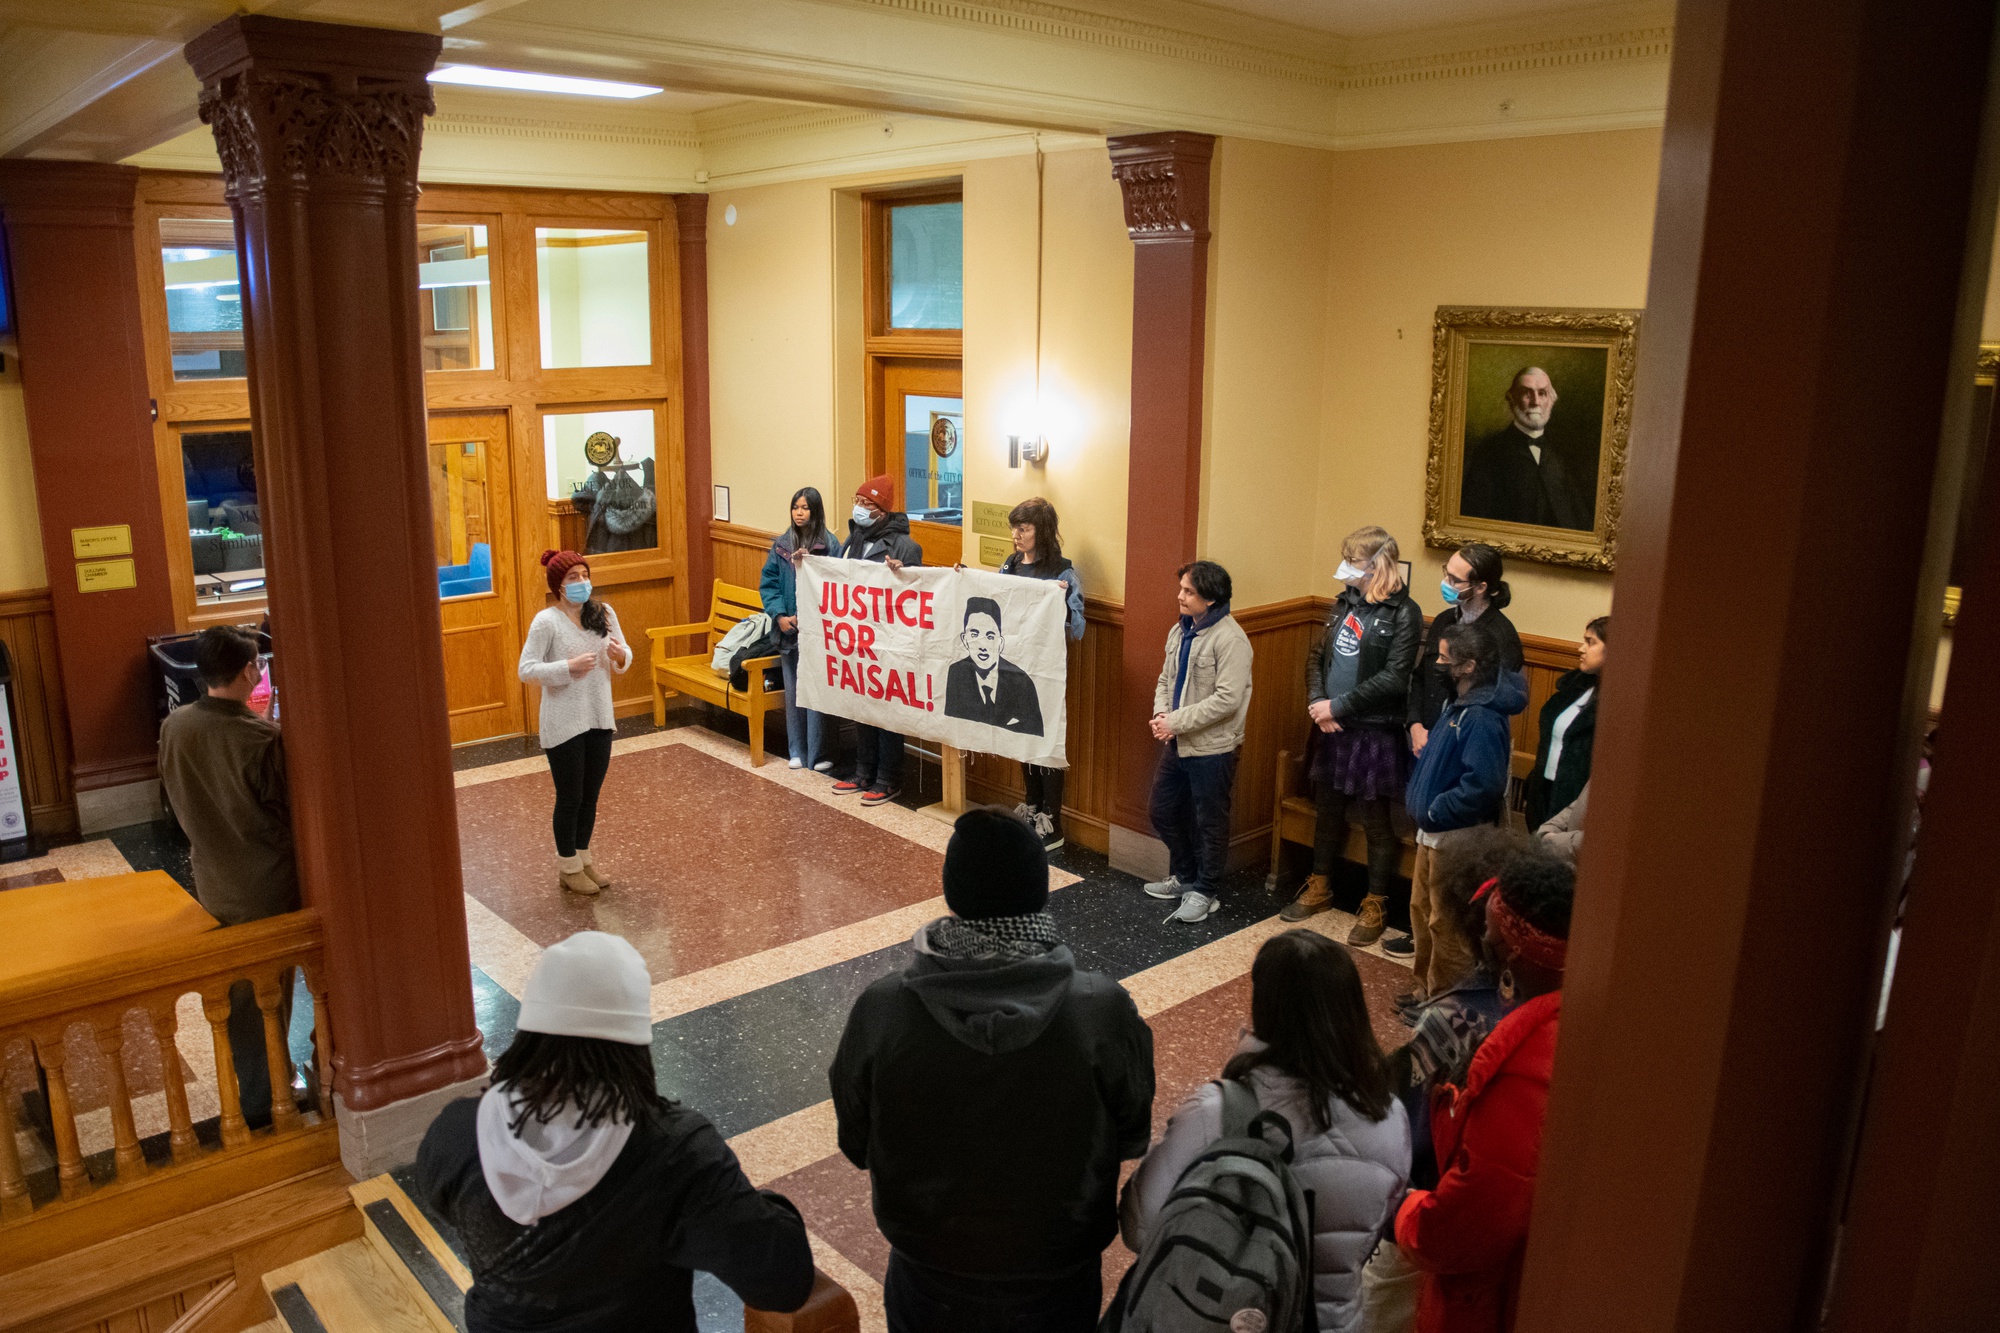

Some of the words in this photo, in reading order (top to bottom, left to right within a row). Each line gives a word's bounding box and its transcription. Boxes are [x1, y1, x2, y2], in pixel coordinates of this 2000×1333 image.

[573, 481, 597, 493] VICE
[908, 467, 927, 479] OFFICE
[934, 471, 943, 480] the
[944, 472, 957, 482] CITY
[976, 518, 991, 527] CITY
[819, 581, 934, 630] JUSTICE
[822, 619, 878, 661] FOR
[826, 654, 934, 712] FAISAL!
